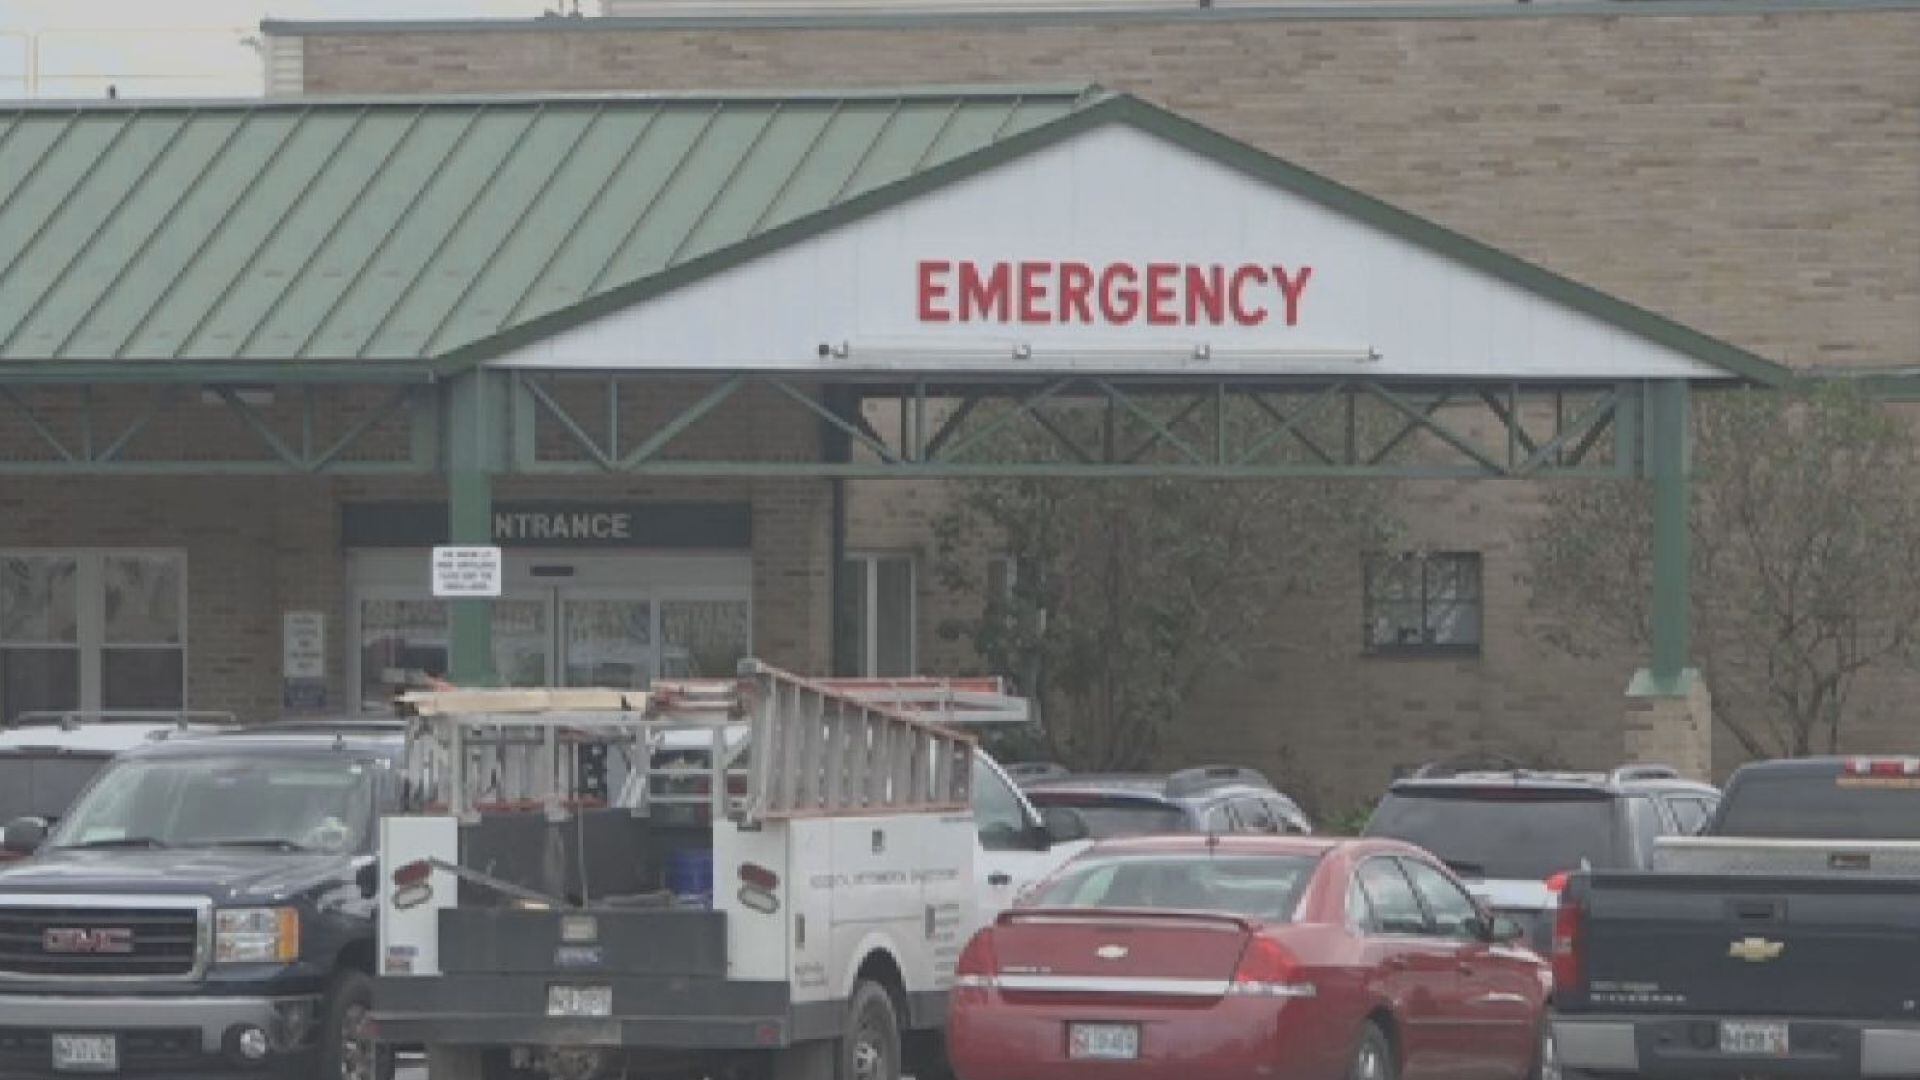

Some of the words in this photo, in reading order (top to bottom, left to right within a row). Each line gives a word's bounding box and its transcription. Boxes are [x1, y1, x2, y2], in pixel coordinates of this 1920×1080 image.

[917, 260, 1312, 327] EMERGENCY
[494, 512, 632, 539] NTRANCE
[43, 927, 134, 953] GMC
